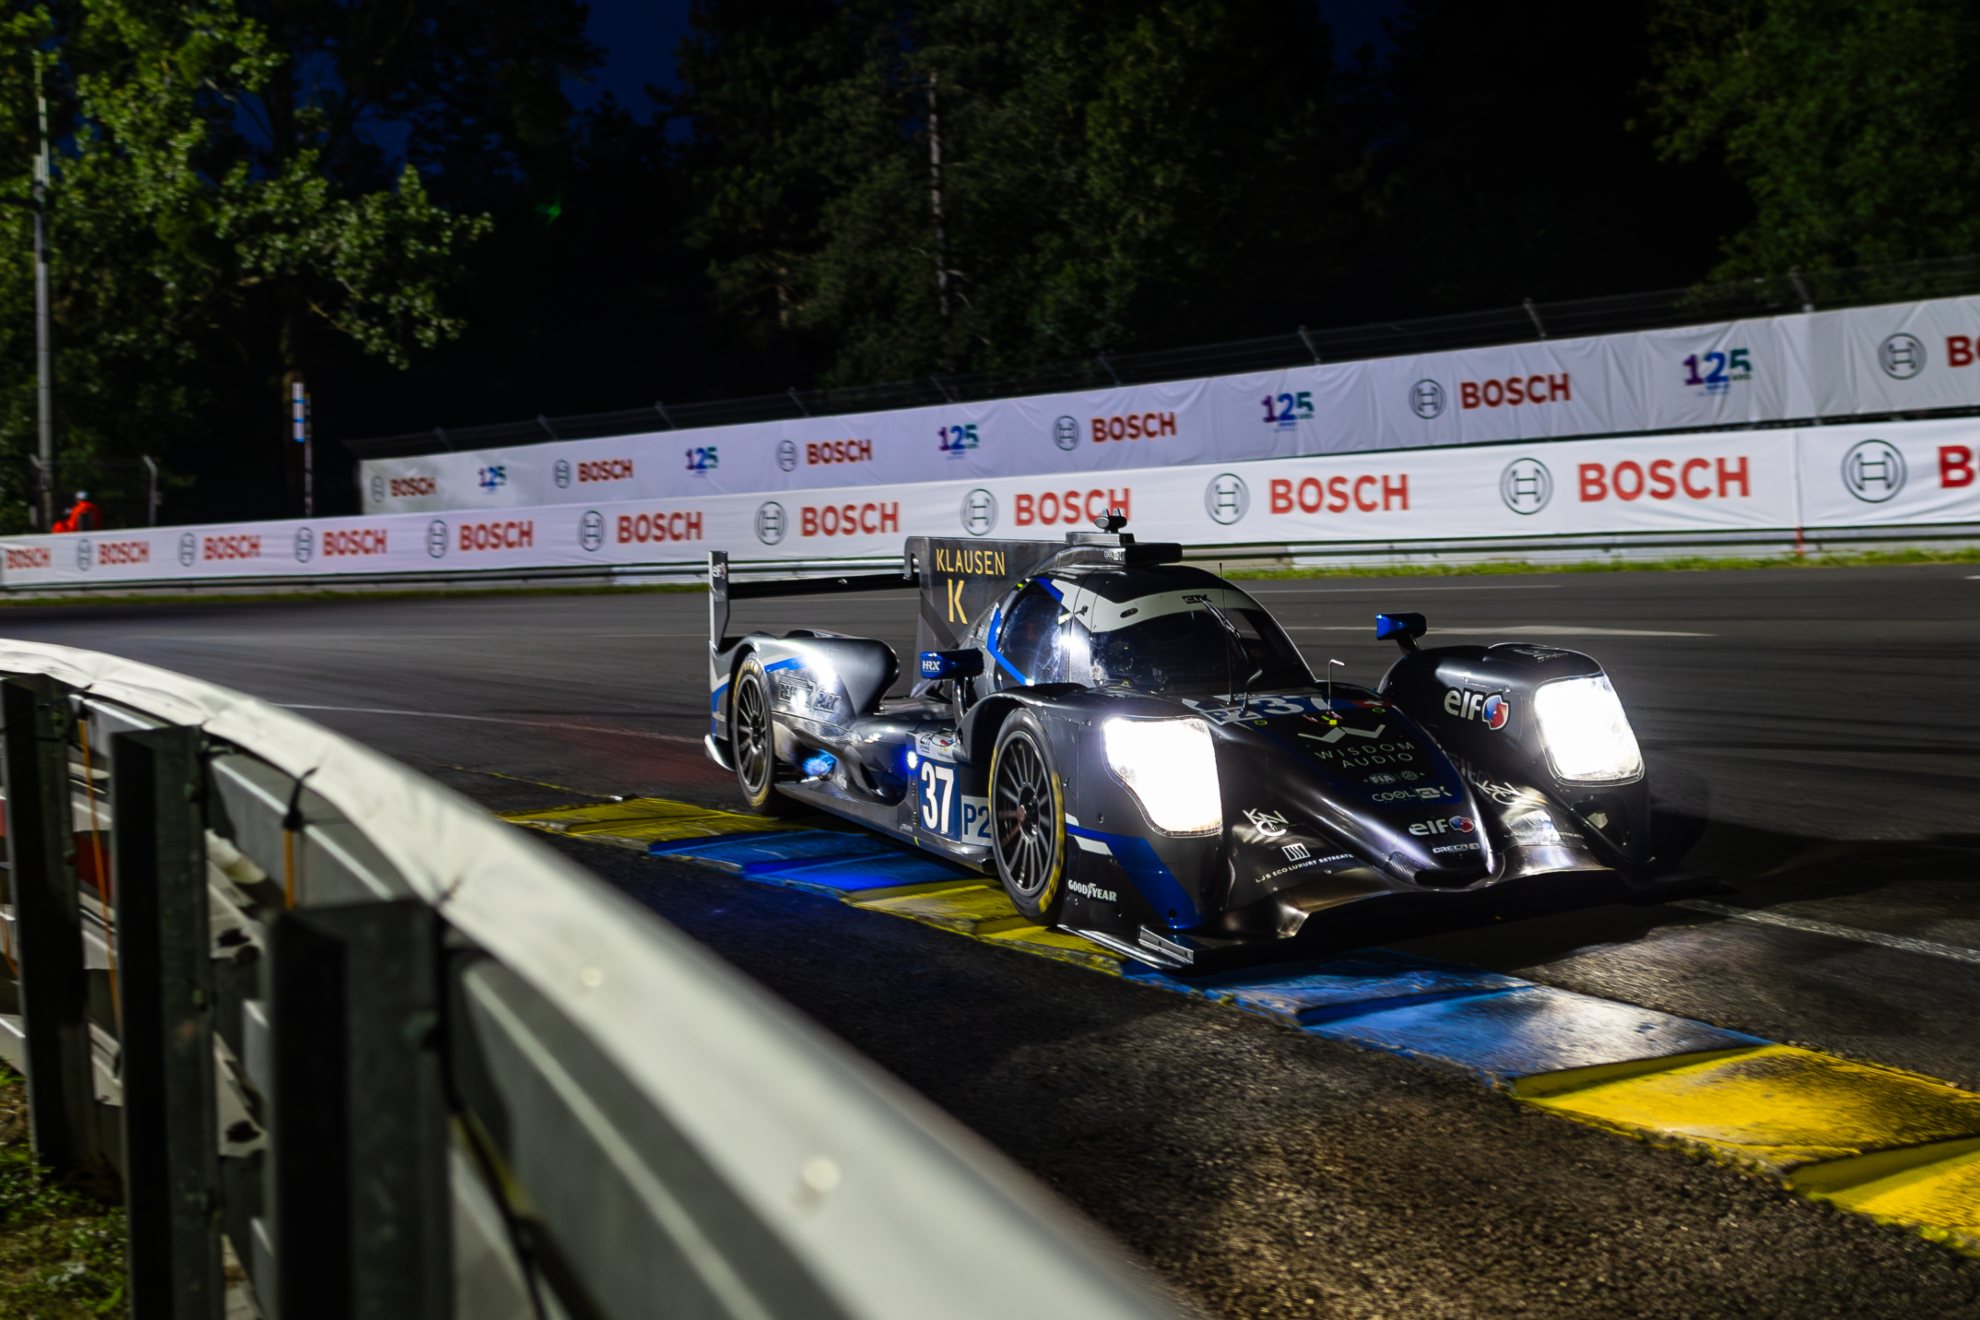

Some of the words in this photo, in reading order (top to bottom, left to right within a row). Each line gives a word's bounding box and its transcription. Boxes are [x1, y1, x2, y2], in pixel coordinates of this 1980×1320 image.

[1946, 335, 1980, 368] B
[1683, 349, 1752, 385] 125
[1460, 373, 1571, 409] BOSCH
[1261, 391, 1314, 422] 125
[938, 424, 979, 451] 125
[1091, 412, 1176, 443] BOSCH
[685, 446, 718, 470] 125
[807, 439, 872, 465] BOSCH
[1937, 444, 1980, 489] B
[578, 459, 633, 482] BOSCH
[1577, 455, 1752, 503] BOSCH
[390, 477, 436, 496] BOSCH
[1269, 473, 1410, 515] BOSCH
[801, 501, 899, 537] BOSCH
[1013, 487, 1132, 527] BOSCH
[322, 529, 388, 556] BOSCH
[458, 521, 534, 551] BOSCH
[616, 512, 704, 544] BOSCH
[6, 547, 51, 570] BOSCH
[98, 541, 150, 565] BOSCH
[203, 535, 261, 560] BOSCH
[935, 548, 1006, 576] KLAUSEN
[947, 578, 968, 625] K
[922, 660, 941, 671] HRX
[1443, 687, 1484, 720] elf
[1313, 740, 1416, 760] WISDOM
[1341, 752, 1414, 768] AUDIO
[920, 761, 955, 834] 37
[1371, 789, 1417, 802] COOL
[963, 803, 992, 837] P2
[1408, 818, 1449, 836] elf
[1255, 873, 1272, 883] LJS
[1272, 867, 1288, 877] ECO
[1288, 859, 1318, 871] LUXURY
[1318, 853, 1355, 863] RETREATS
[1067, 879, 1117, 902] GOODYEAR
